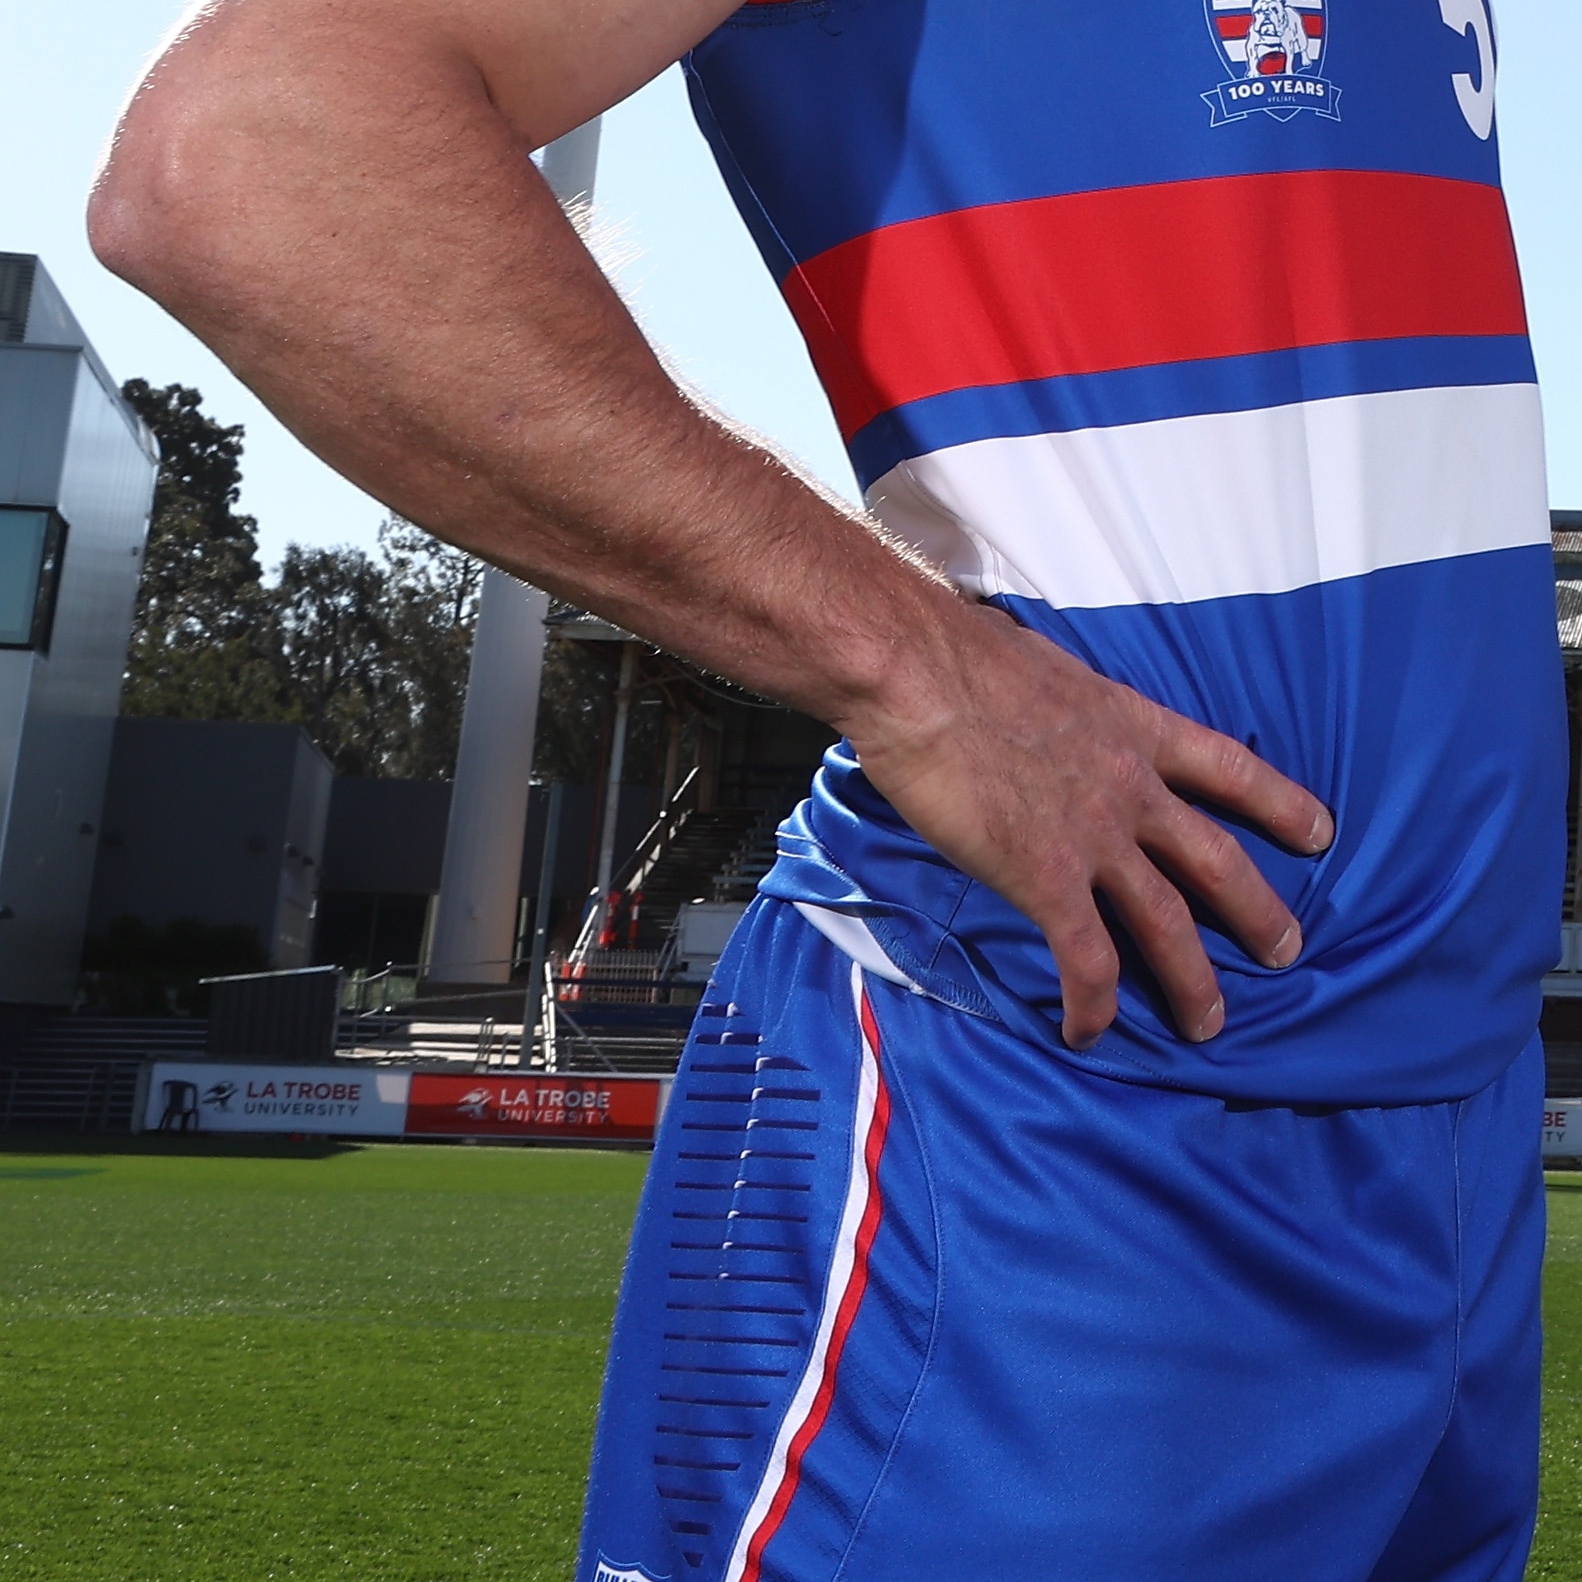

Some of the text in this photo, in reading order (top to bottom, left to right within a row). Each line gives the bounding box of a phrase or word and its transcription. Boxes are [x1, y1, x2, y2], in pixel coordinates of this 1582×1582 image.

[1228, 80, 1325, 100] 100 YEARS
[246, 1081, 363, 1101] LA TROBE
[500, 1088, 612, 1109] LA TROBE
[244, 1102, 360, 1116] UNIVERSITY
[497, 1108, 609, 1124] UNIVERSITY
